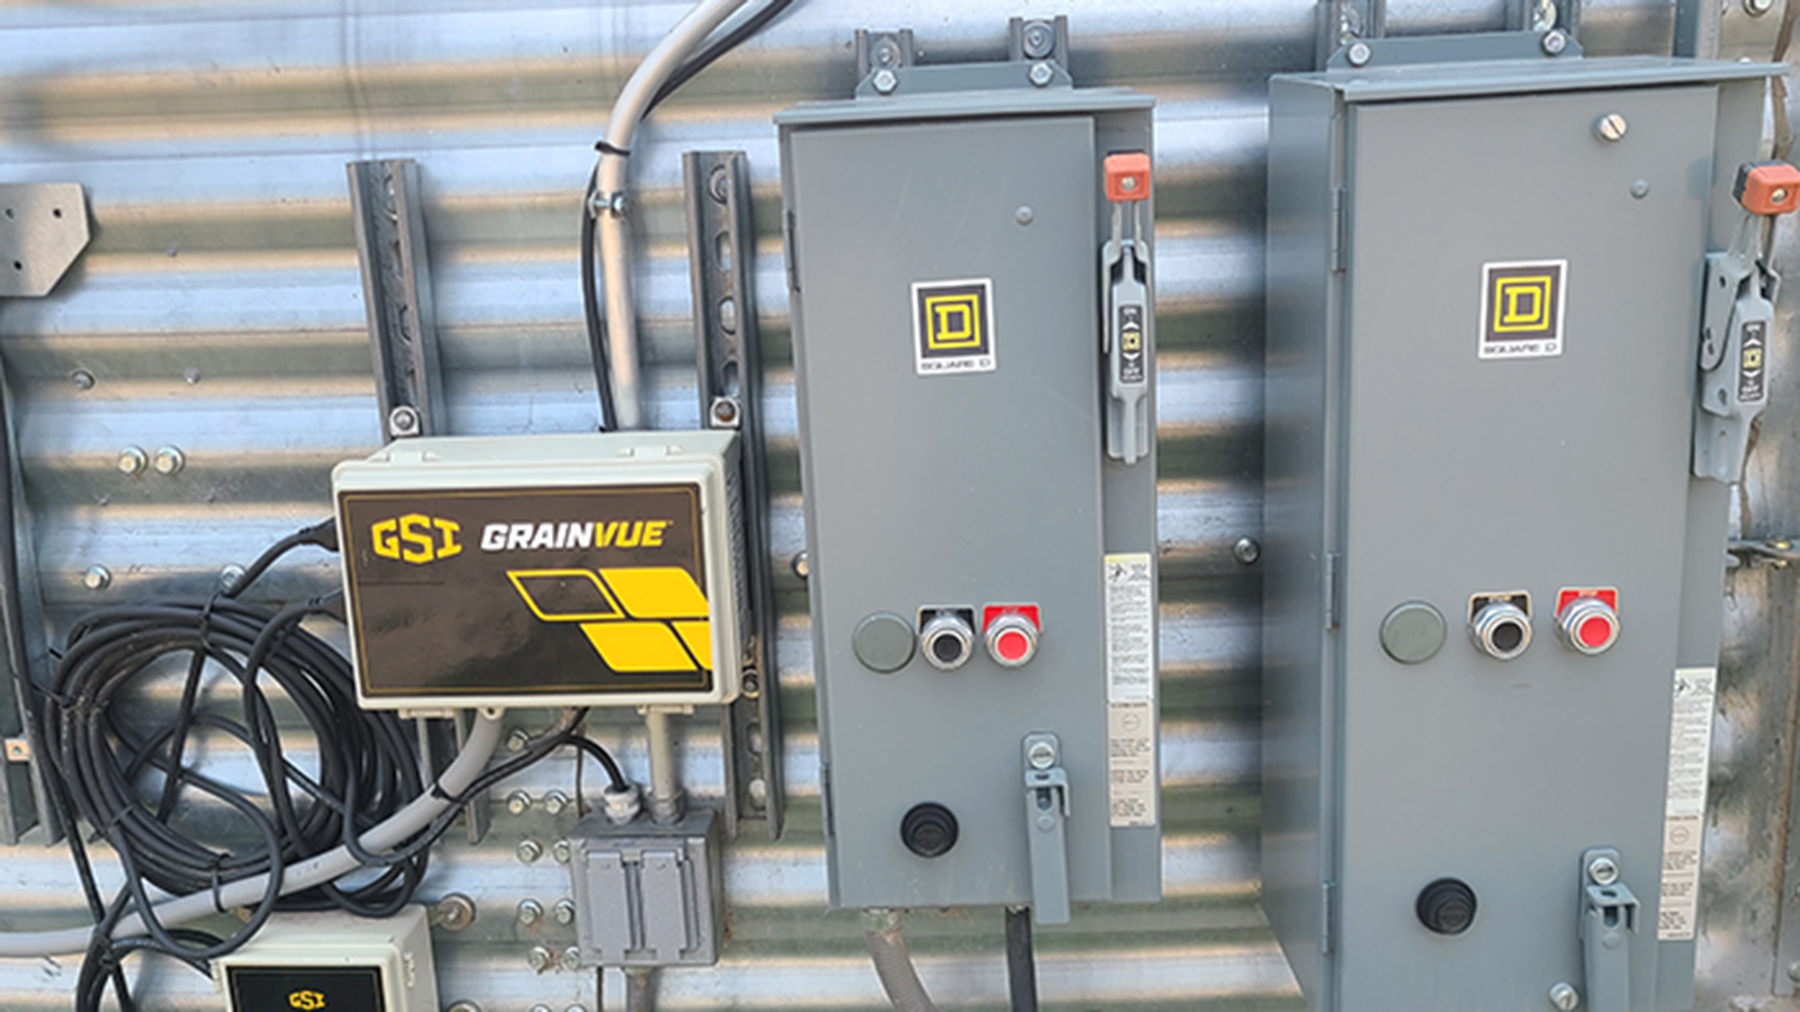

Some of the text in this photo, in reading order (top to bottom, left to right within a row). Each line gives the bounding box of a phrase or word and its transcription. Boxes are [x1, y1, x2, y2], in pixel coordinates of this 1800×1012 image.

[1483, 342, 1558, 355] SQUARE D
[979, 358, 991, 368] D
[371, 513, 667, 563] GSI GRAINVUE
[289, 989, 325, 1010] GSI
